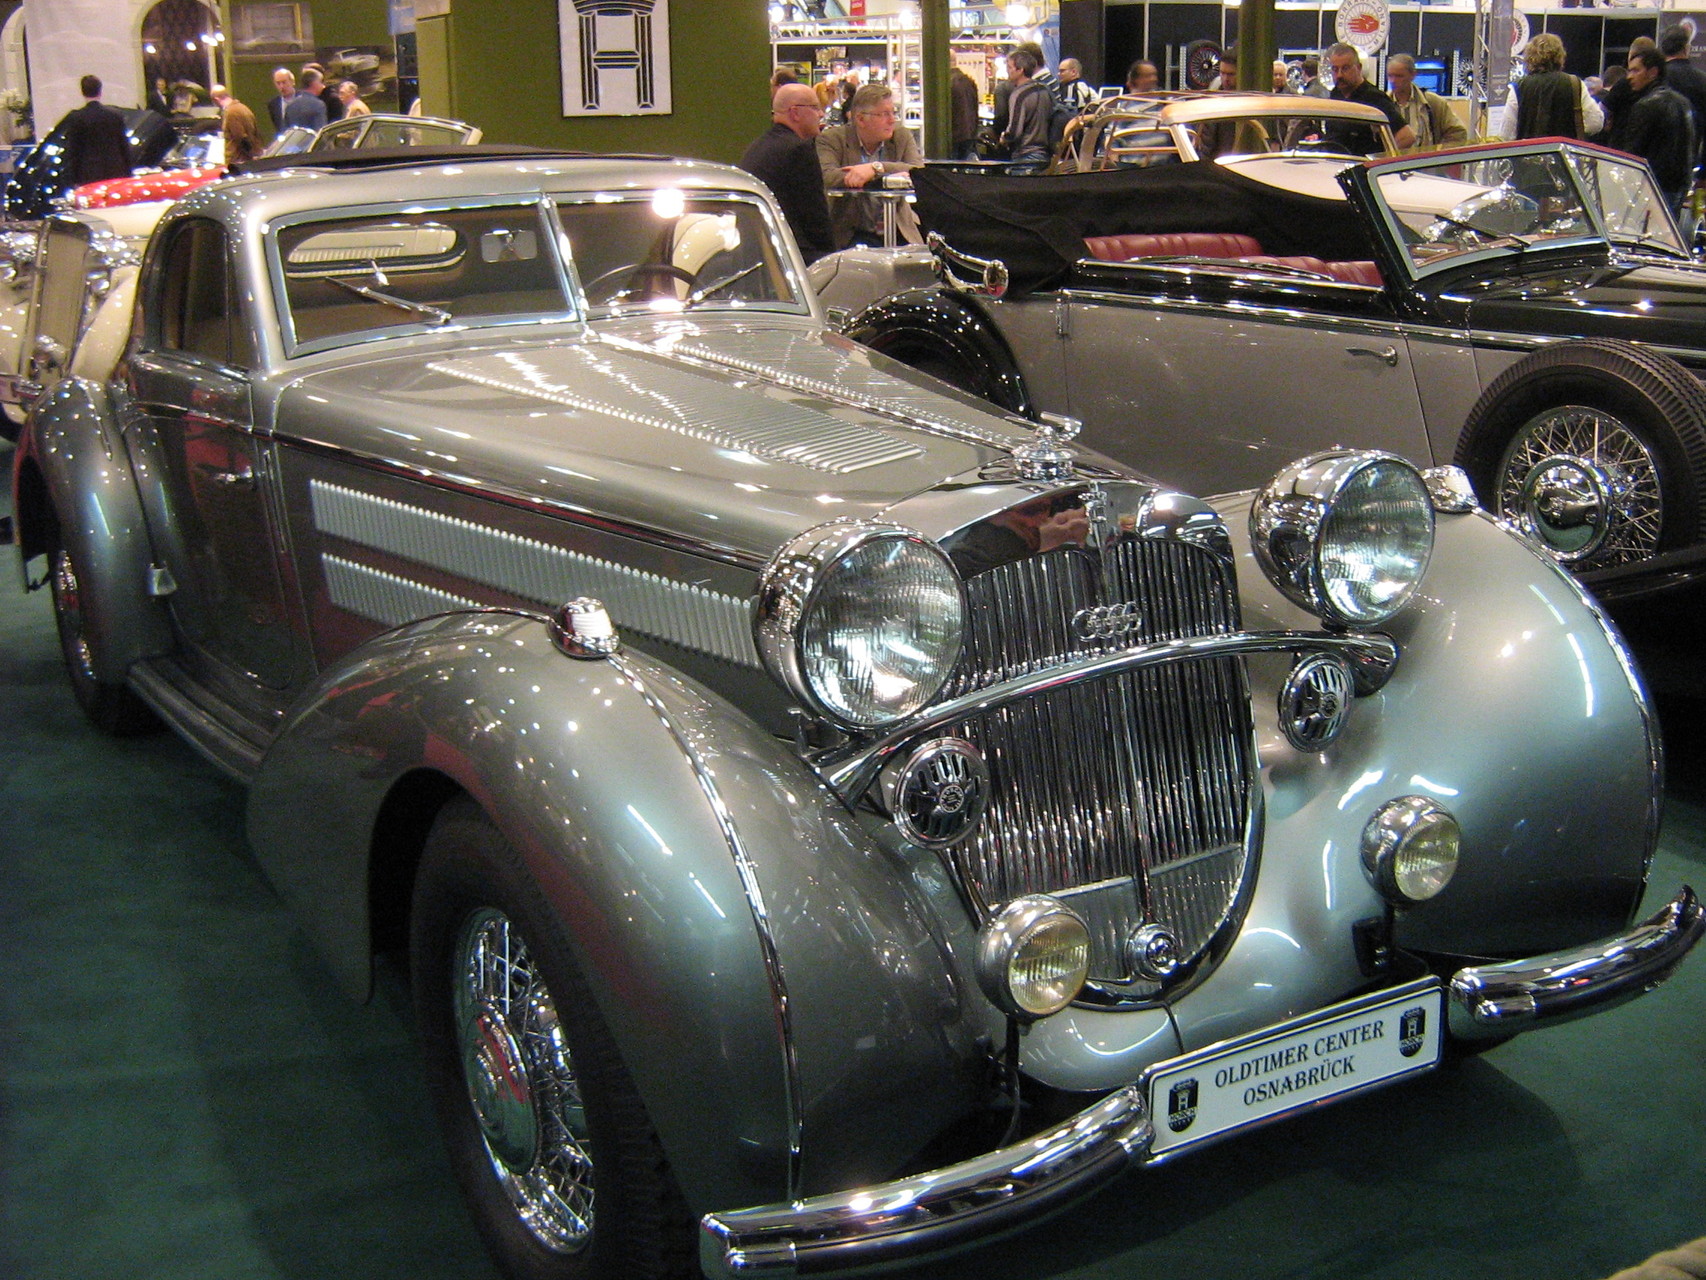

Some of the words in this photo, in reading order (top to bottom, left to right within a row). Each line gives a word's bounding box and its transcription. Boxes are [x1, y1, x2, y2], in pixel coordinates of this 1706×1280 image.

[1215, 1043, 1309, 1088] OLDTIMER
[1314, 1020, 1385, 1056] CENTER
[1244, 1056, 1356, 1106] OSNABRÜCK
